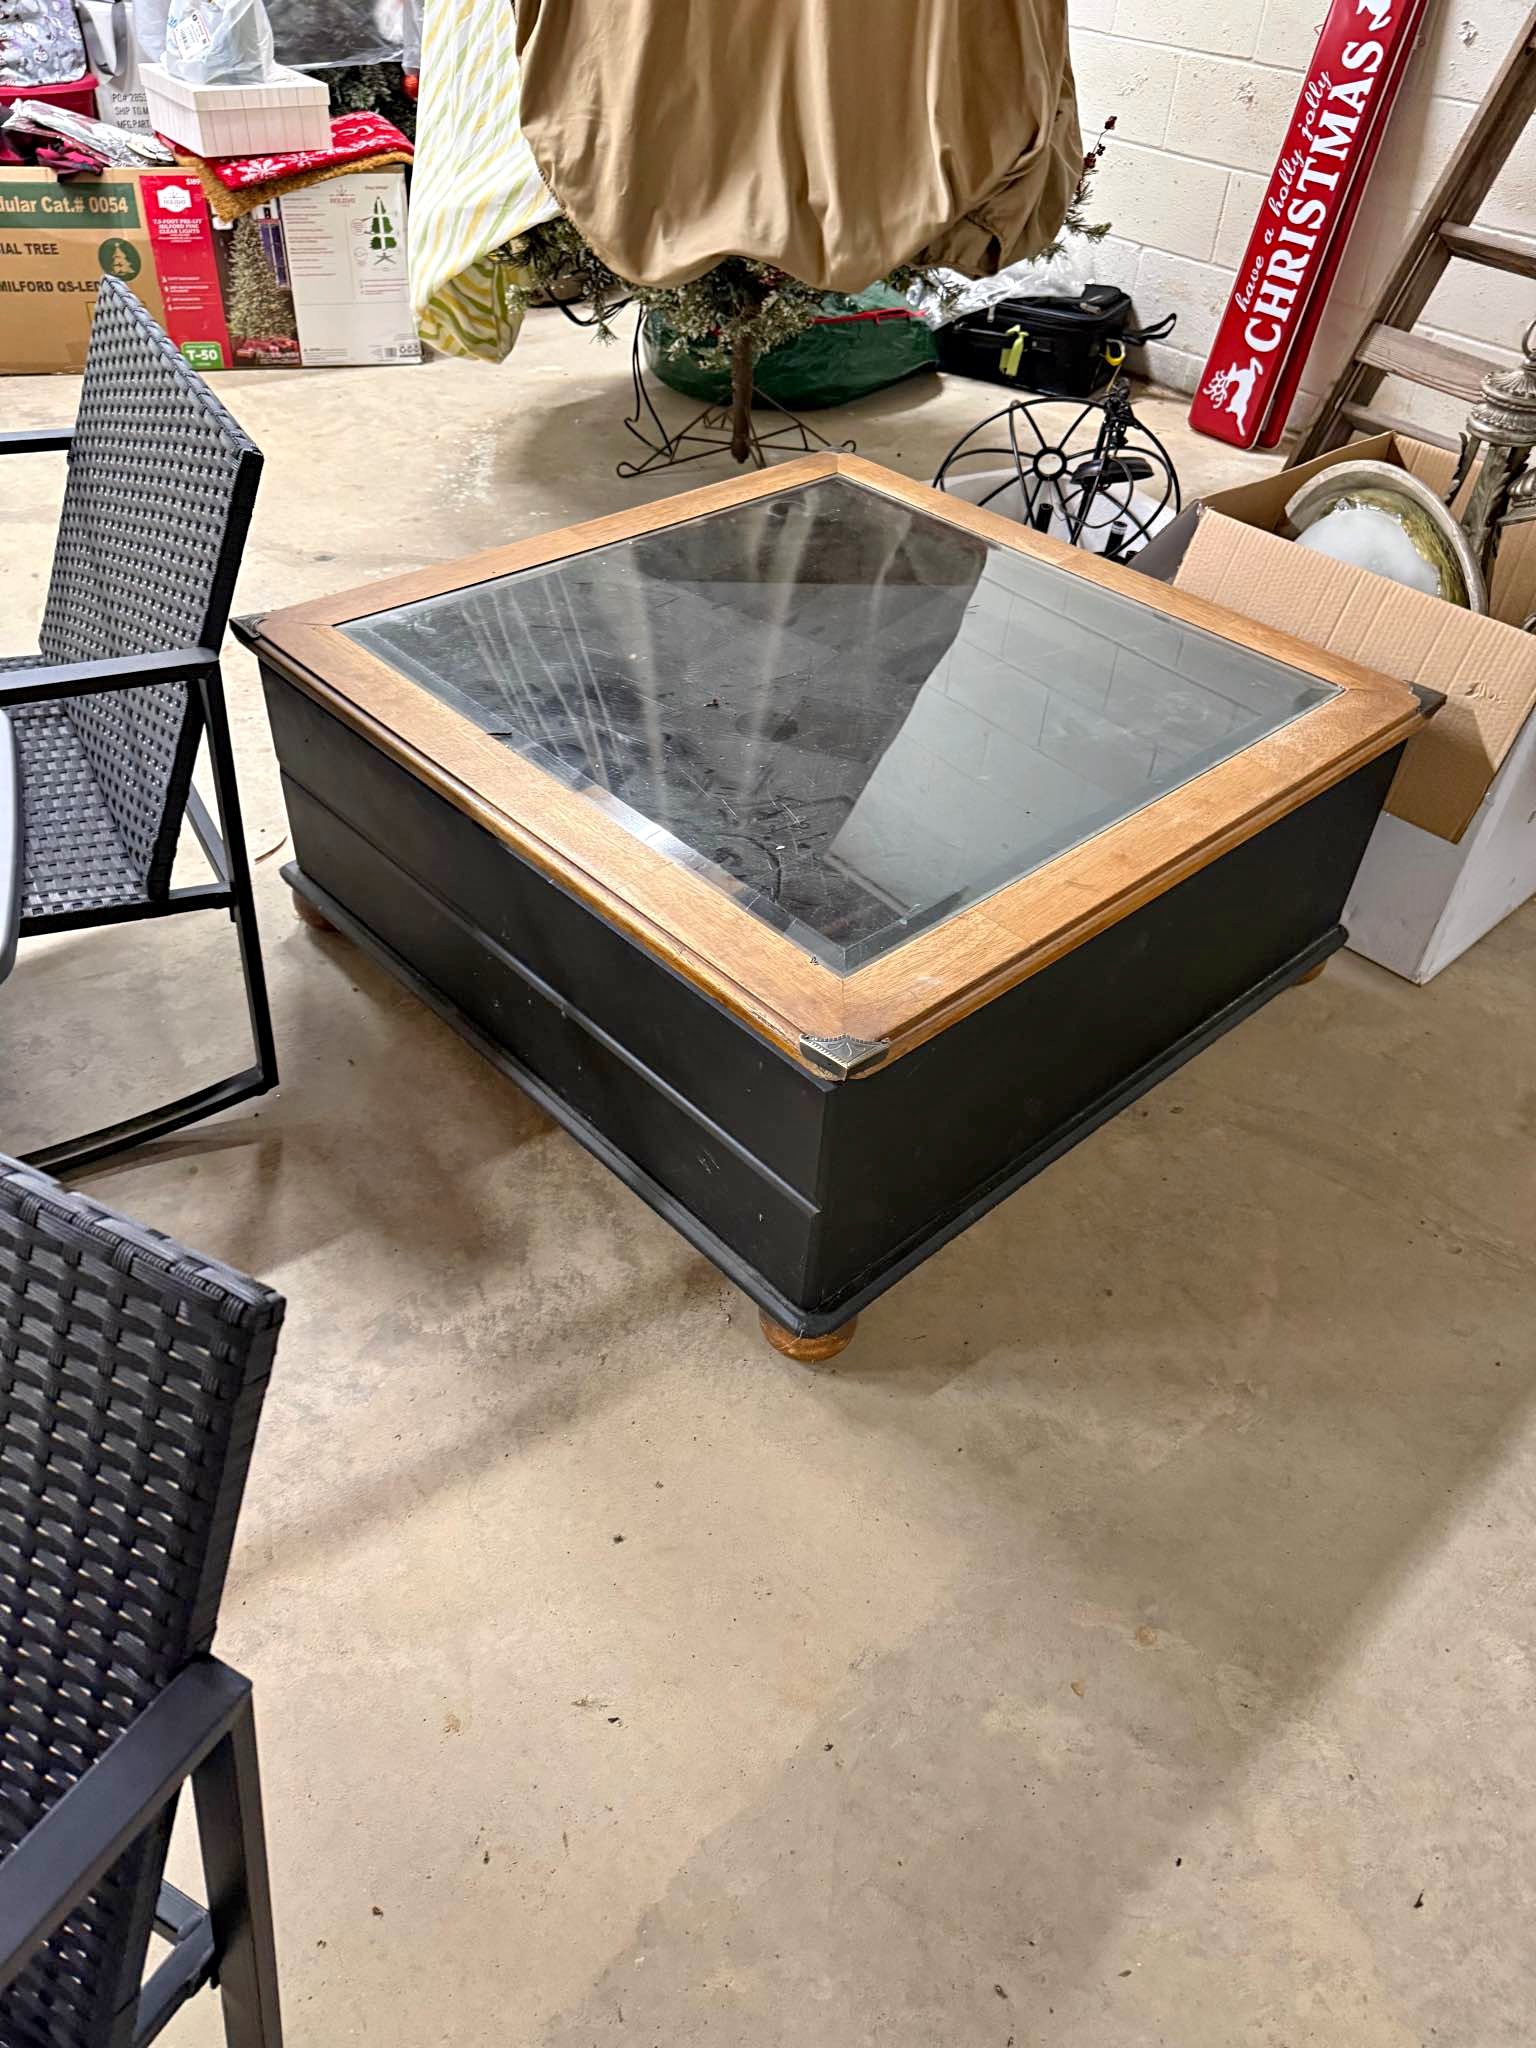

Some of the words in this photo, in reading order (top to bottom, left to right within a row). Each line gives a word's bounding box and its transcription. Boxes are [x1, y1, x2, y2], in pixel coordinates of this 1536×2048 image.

[1297, 70, 1332, 142] jolly
[1267, 147, 1305, 218] holly
[88, 196, 129, 213] 0054
[1243, 39, 1384, 353] CHRISTMAS
[1263, 227, 1275, 245] a
[24, 242, 60, 255] TREE
[0, 280, 54, 293] MILFORD
[1234, 255, 1265, 313] have
[187, 349, 218, 361] T-50
